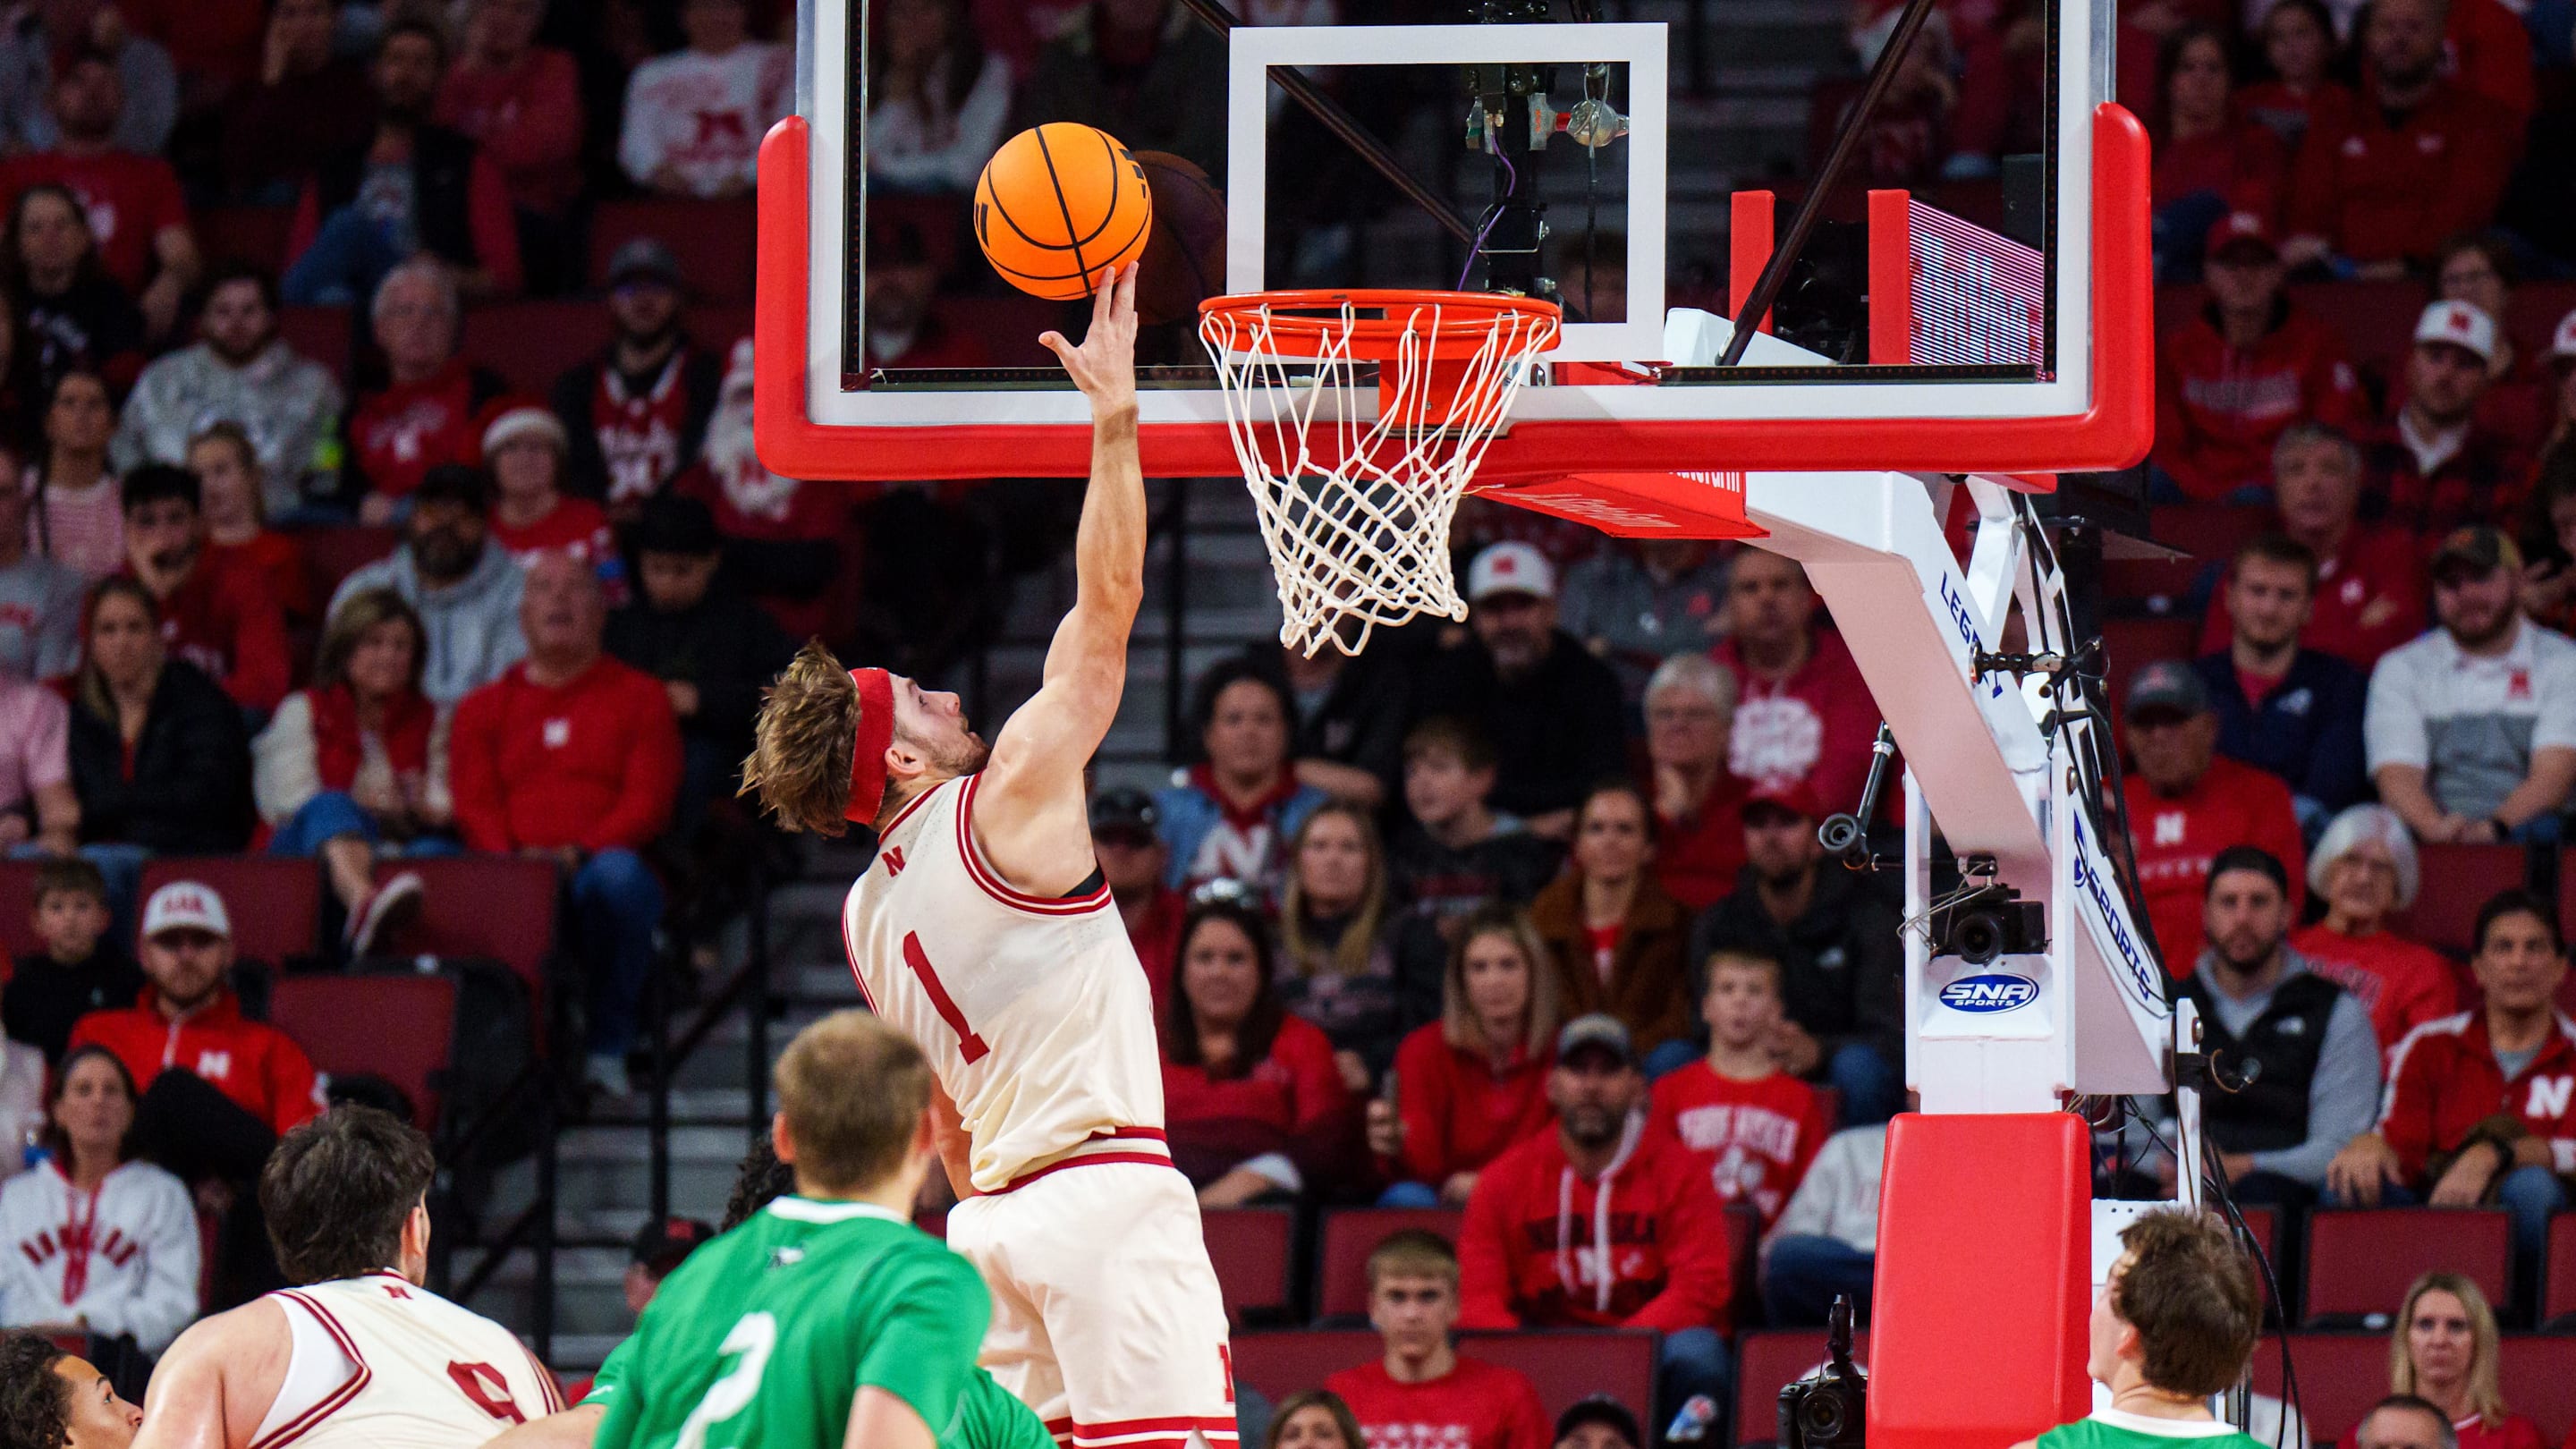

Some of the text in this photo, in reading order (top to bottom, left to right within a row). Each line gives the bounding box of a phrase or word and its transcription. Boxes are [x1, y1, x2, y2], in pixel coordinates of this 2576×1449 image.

[881, 844, 906, 877] N
[1191, 822, 1268, 880] N
[2087, 866, 2150, 1001] SPORTS
[902, 929, 990, 1065] 1
[1941, 983, 2032, 1000] SNA
[1953, 999, 2016, 1007] SPORTS
[2525, 1073, 2574, 1120] N
[445, 1360, 528, 1426] 9
[671, 1310, 778, 1449] 2
